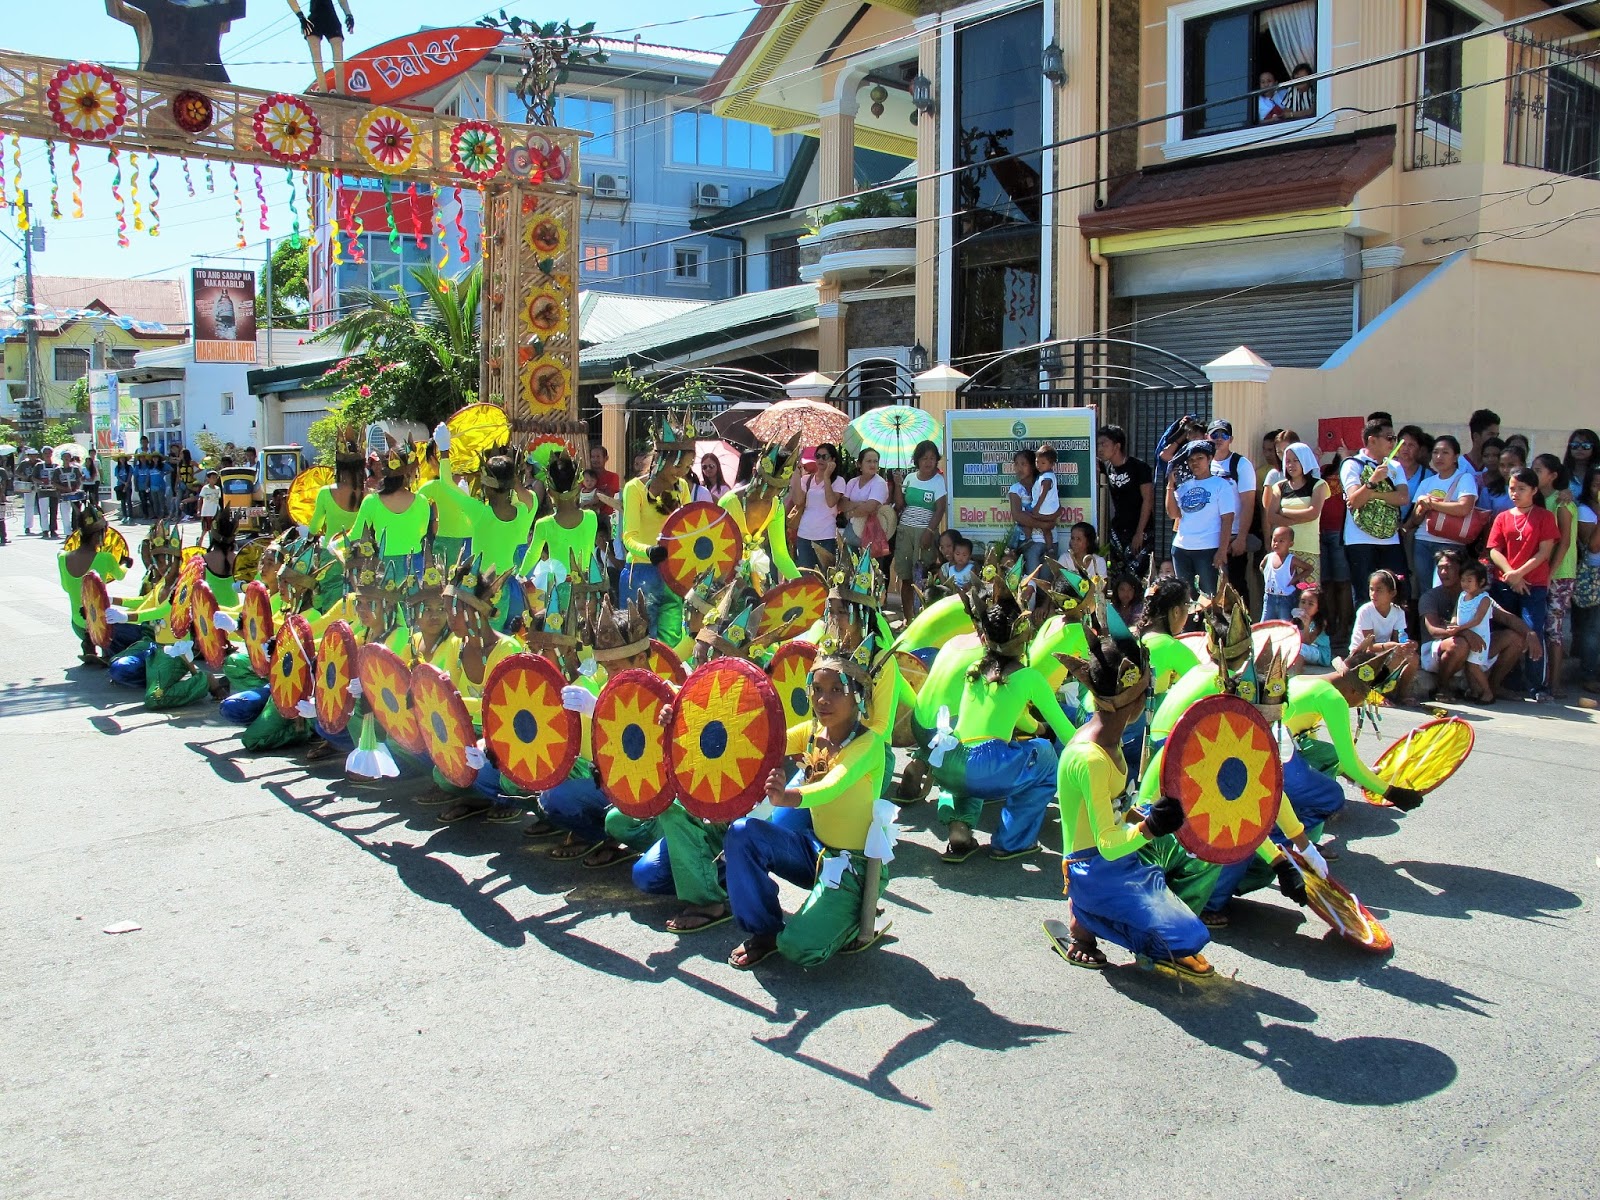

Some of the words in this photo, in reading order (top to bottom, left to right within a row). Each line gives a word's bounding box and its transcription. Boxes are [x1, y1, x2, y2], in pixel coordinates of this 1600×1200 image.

[372, 34, 460, 89] Baler
[196, 270, 207, 279] ITO
[207, 271, 221, 280] ANG
[221, 272, 242, 281] SARAP
[242, 273, 252, 281] NA
[204, 279, 245, 289] NAKAKABILIB
[237, 342, 256, 362] HOTEL
[953, 441, 979, 452] MUNICIPAL
[979, 441, 1013, 452] ENVIRONMENT
[1071, 440, 1089, 451] OFFICE
[982, 452, 1009, 463] MUNICIPAL
[960, 506, 987, 523] Baler
[990, 507, 1014, 523] Tow
[1060, 506, 1084, 523] 2015
